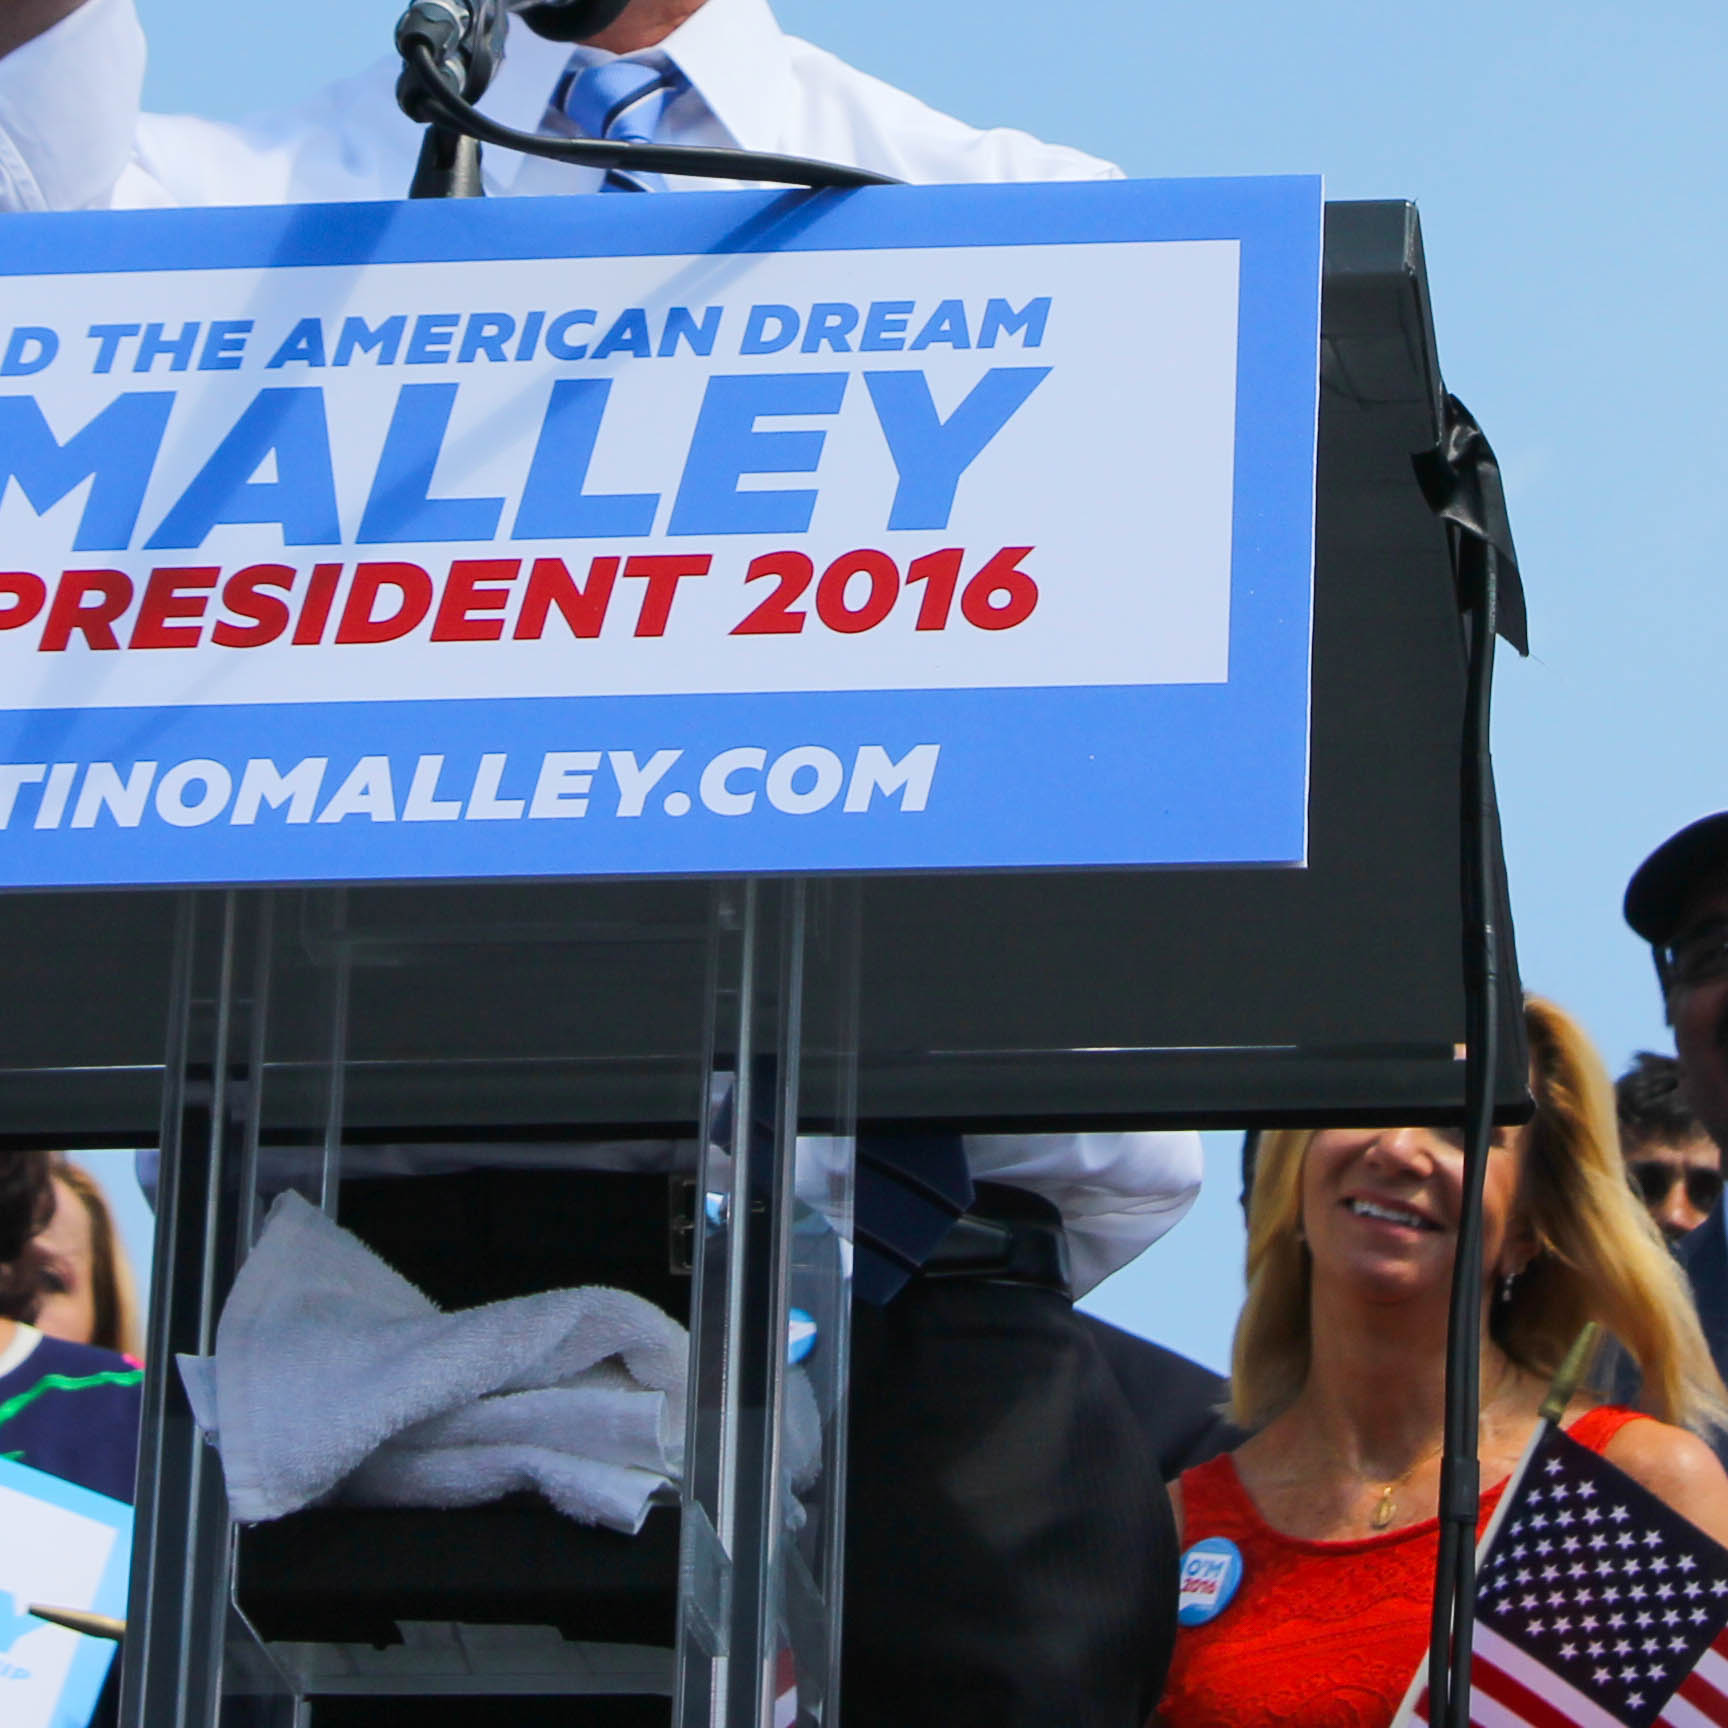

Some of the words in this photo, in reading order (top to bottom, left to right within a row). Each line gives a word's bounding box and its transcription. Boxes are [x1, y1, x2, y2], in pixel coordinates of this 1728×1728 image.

[87, 317, 256, 374] THE
[264, 304, 725, 370] AMERICAN
[738, 295, 1054, 356] DREAM
[730, 547, 1040, 636] 2016
